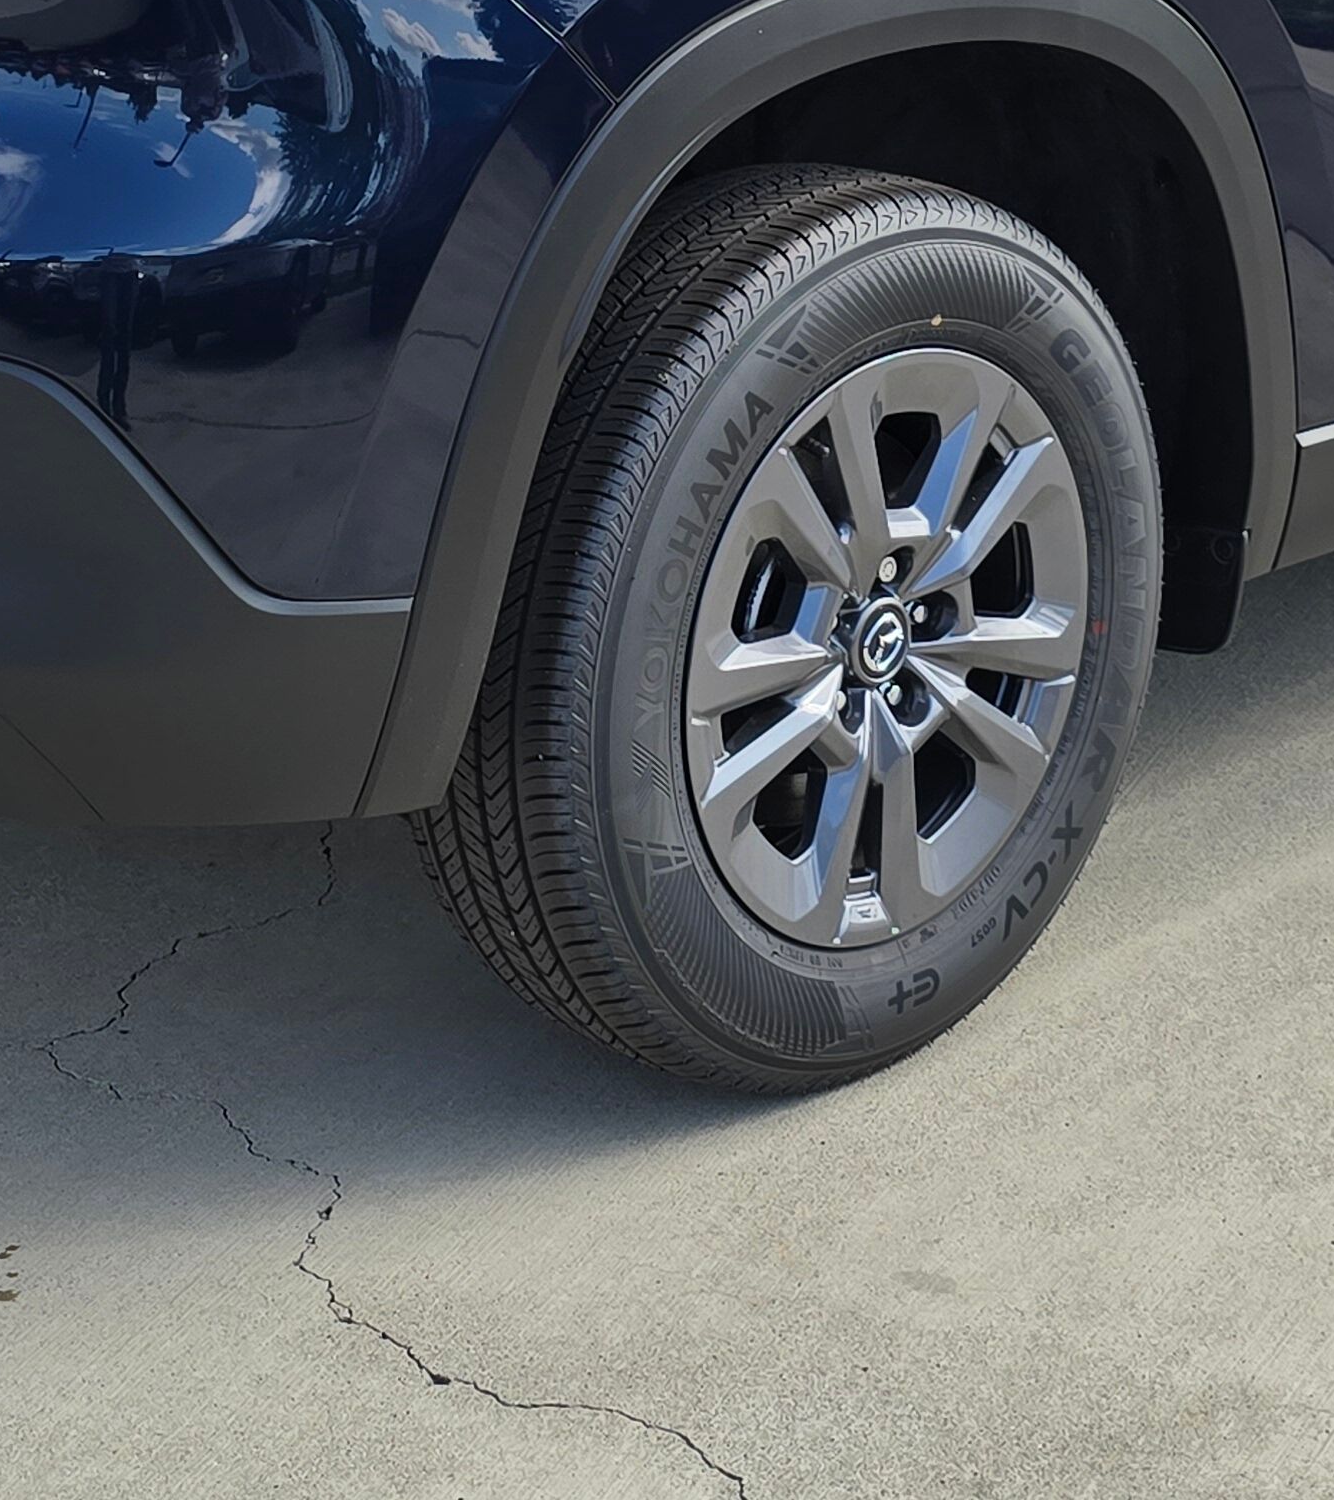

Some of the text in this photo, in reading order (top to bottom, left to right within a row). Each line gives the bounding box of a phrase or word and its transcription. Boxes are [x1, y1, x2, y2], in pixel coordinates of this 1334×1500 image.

[631, 389, 776, 736] YOKOHAMA
[1049, 327, 1149, 793] GEOLANDAR
[1002, 799, 1084, 943] X-CV
